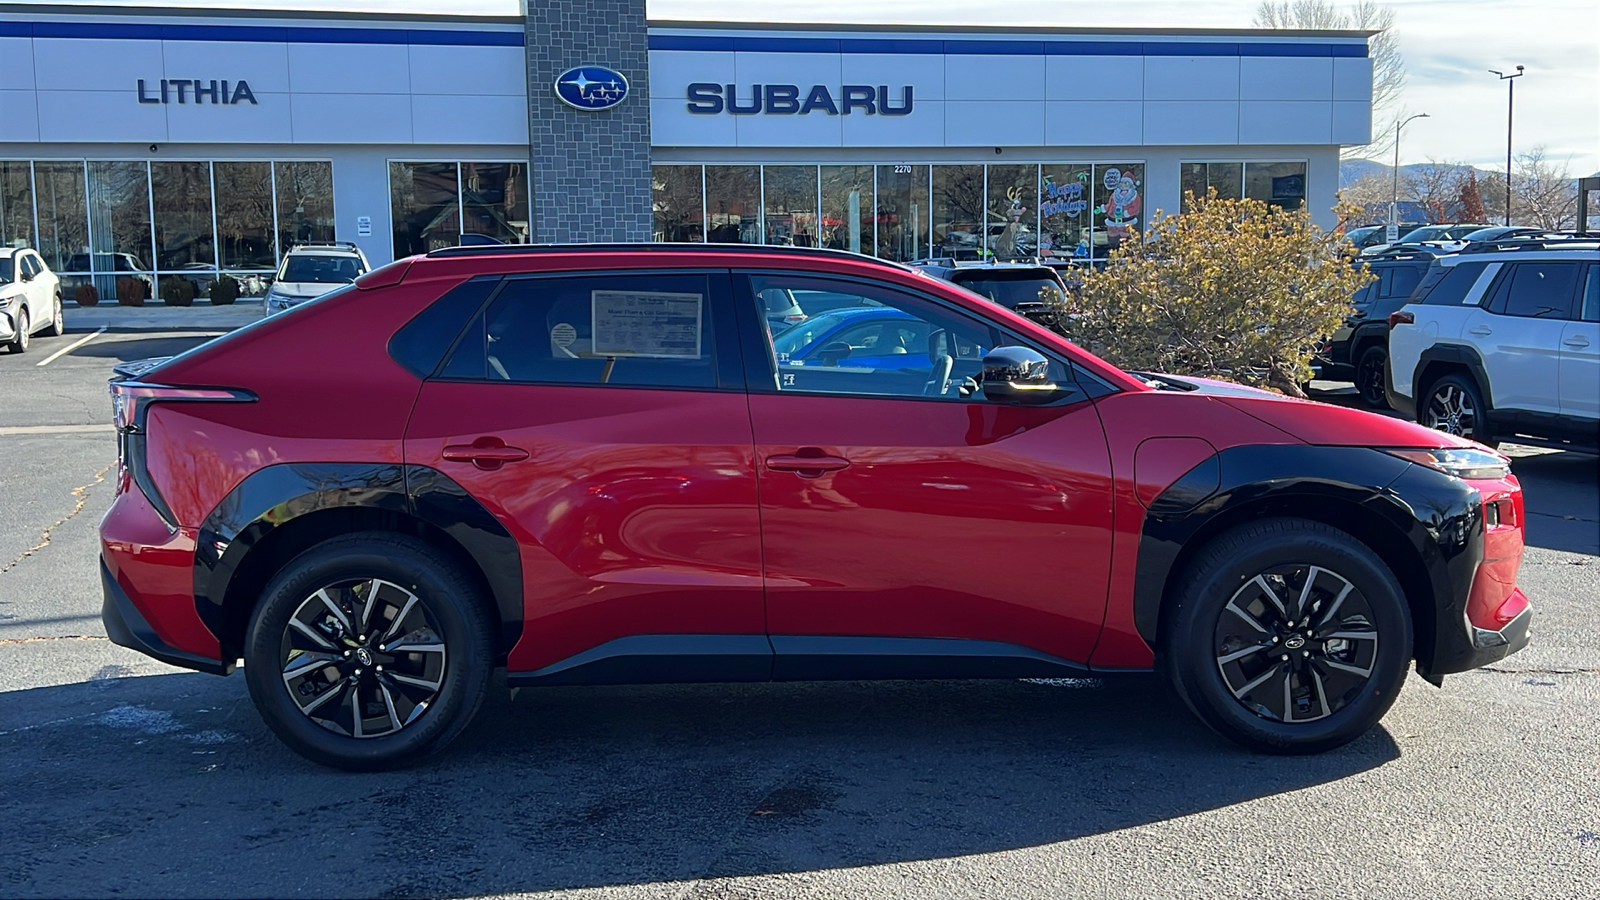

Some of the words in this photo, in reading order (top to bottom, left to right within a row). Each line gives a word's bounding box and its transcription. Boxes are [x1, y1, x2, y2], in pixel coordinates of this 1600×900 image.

[137, 79, 258, 104] LITHIA
[687, 82, 914, 115] SUBARU
[894, 165, 912, 174] 2270
[1046, 182, 1083, 199] Happy
[1041, 199, 1087, 217] Holidays
